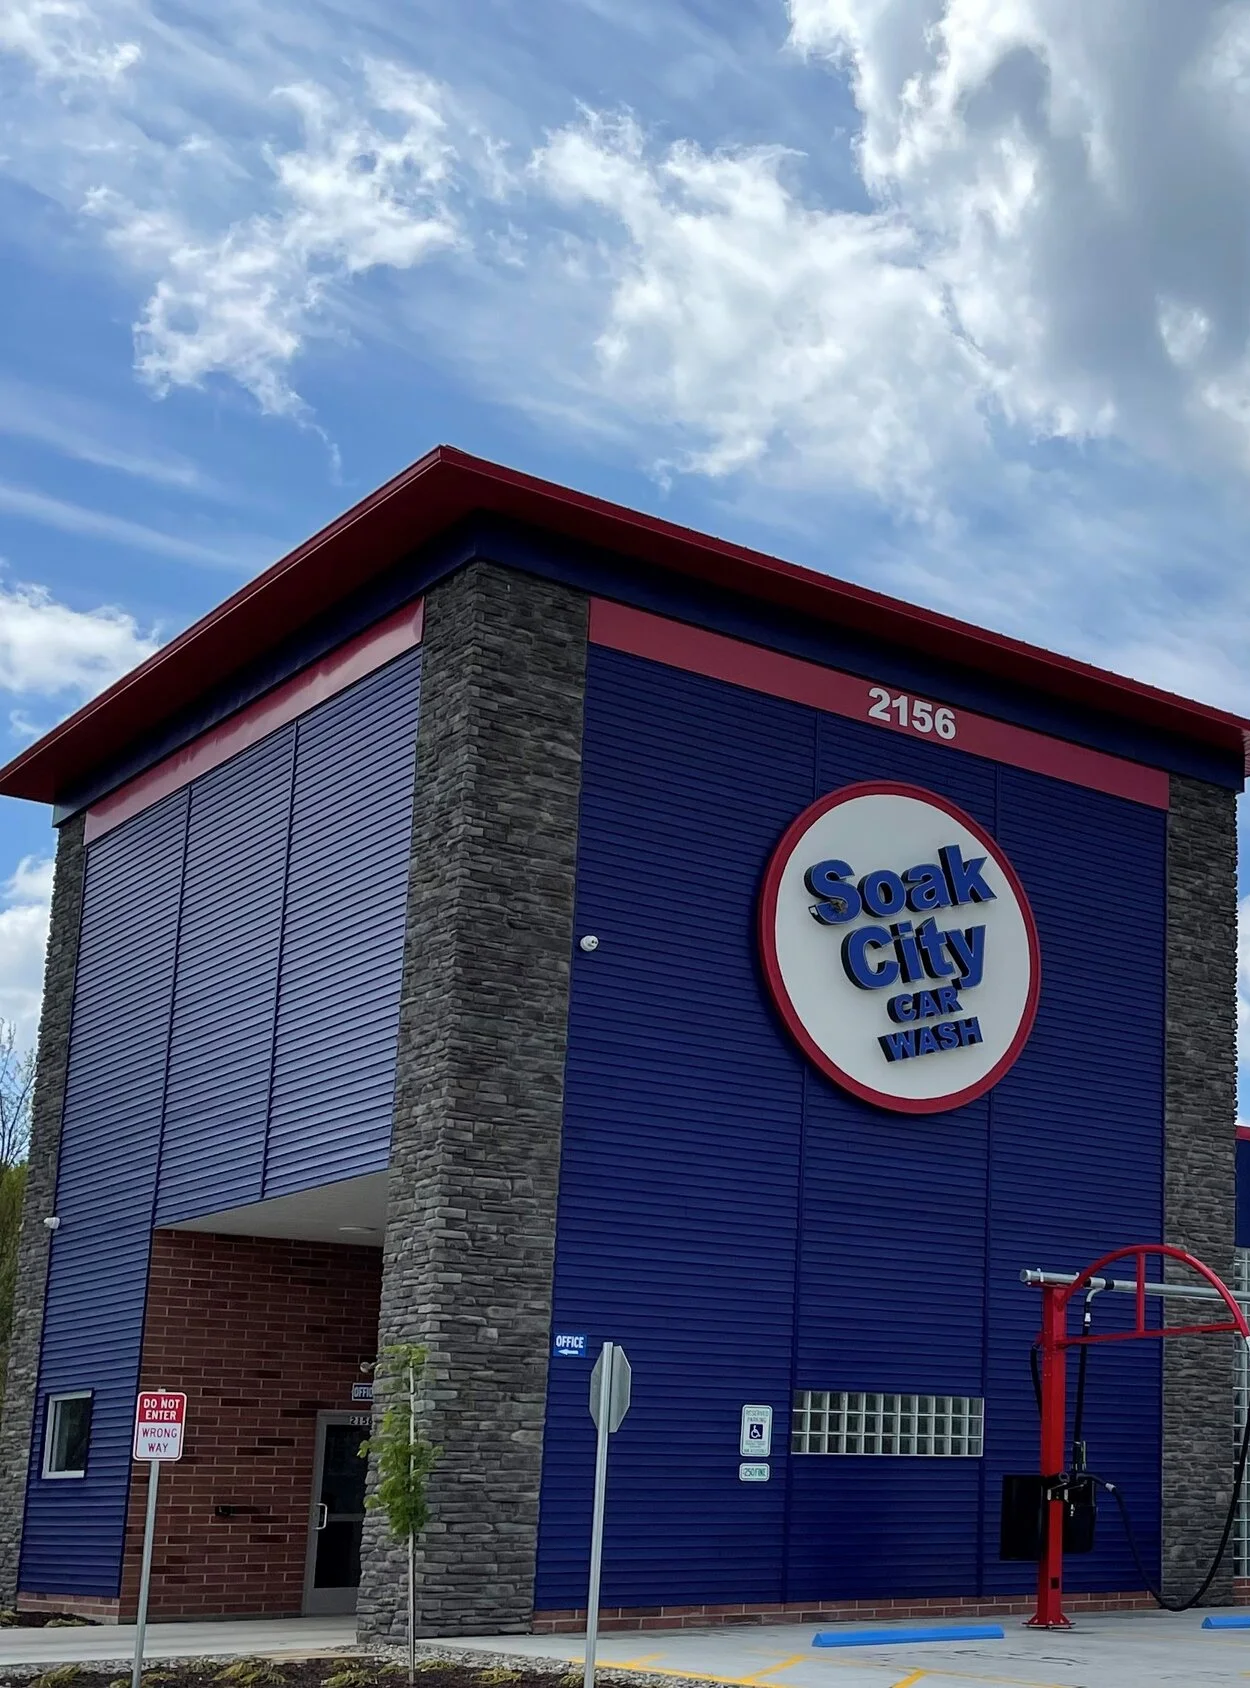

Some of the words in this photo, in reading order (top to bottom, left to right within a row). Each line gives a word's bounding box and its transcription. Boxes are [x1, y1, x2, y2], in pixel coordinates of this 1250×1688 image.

[868, 687, 957, 740] 2156
[804, 844, 998, 926] Soak
[841, 916, 987, 990] City
[887, 985, 963, 1023] CAR
[878, 1016, 983, 1063] WASH
[555, 1335, 584, 1348] OFFICE
[354, 1386, 373, 1398] OFFIC
[143, 1398, 158, 1409] DO
[160, 1398, 181, 1409] NOT
[145, 1409, 177, 1420] ENTER
[350, 1416, 373, 1425] 2156
[141, 1427, 178, 1439] WRONG
[147, 1442, 169, 1453] WAY
